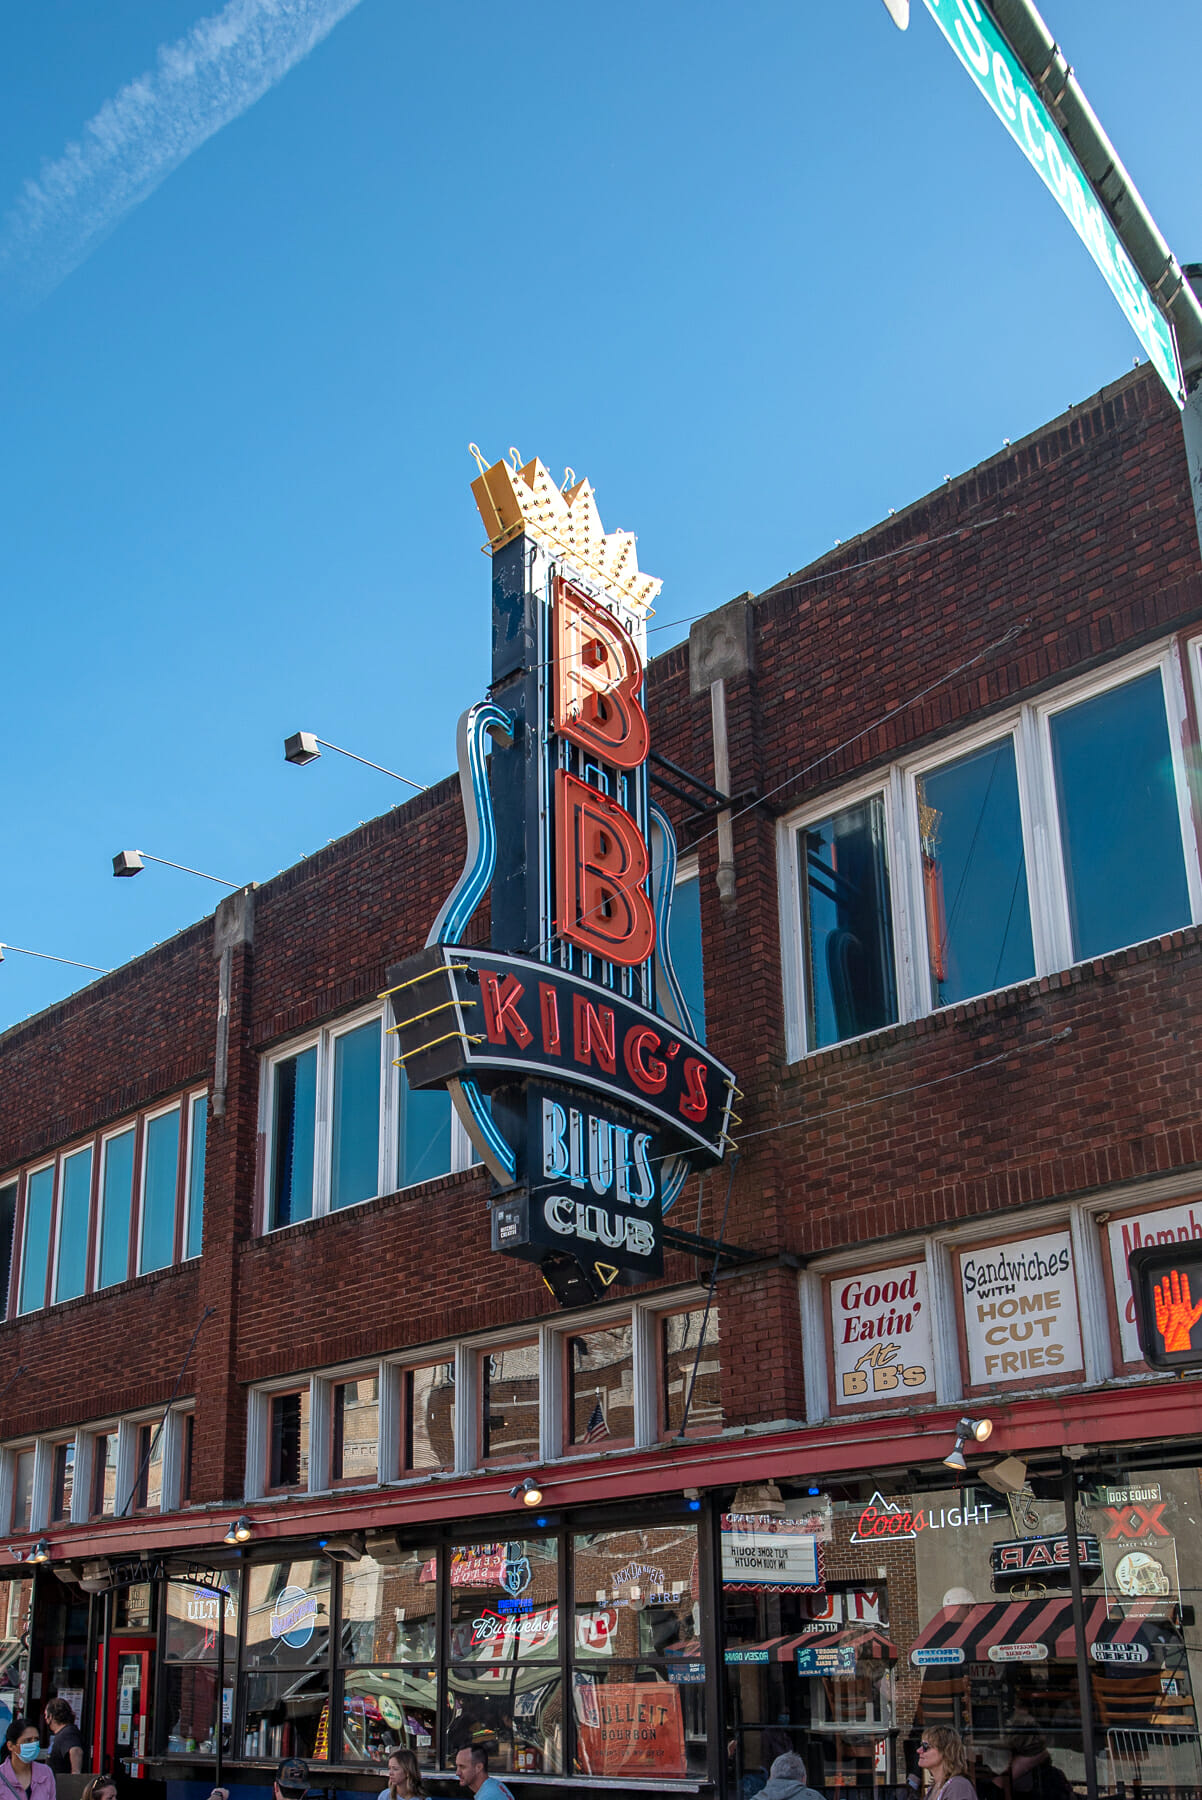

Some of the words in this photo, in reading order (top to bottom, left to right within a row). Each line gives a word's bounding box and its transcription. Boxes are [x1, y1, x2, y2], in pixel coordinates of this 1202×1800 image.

[478, 969, 709, 1123] KING'S
[542, 1096, 655, 1209] BLUES
[543, 1194, 656, 1257] CLUB
[964, 1248, 1071, 1294] Sandwiches
[841, 1269, 919, 1311] Good
[976, 1283, 1017, 1300] WITH
[976, 1289, 1062, 1323] HOME
[841, 1301, 922, 1345] Eatin'
[985, 1315, 1058, 1346] CUT
[854, 1342, 902, 1372] At
[984, 1343, 1066, 1376] FRIES
[1109, 1491, 1128, 1503] DOS
[1129, 1489, 1158, 1501] EQUIS
[858, 1506, 930, 1538] Coors
[928, 1504, 993, 1529] LIGHT
[1103, 1503, 1170, 1539] XX
[649, 1592, 681, 1604] FIRE
[472, 1615, 559, 1639] Budweiser
[600, 1703, 669, 1727] ULLEIT
[601, 1727, 657, 1741] BOURBON
